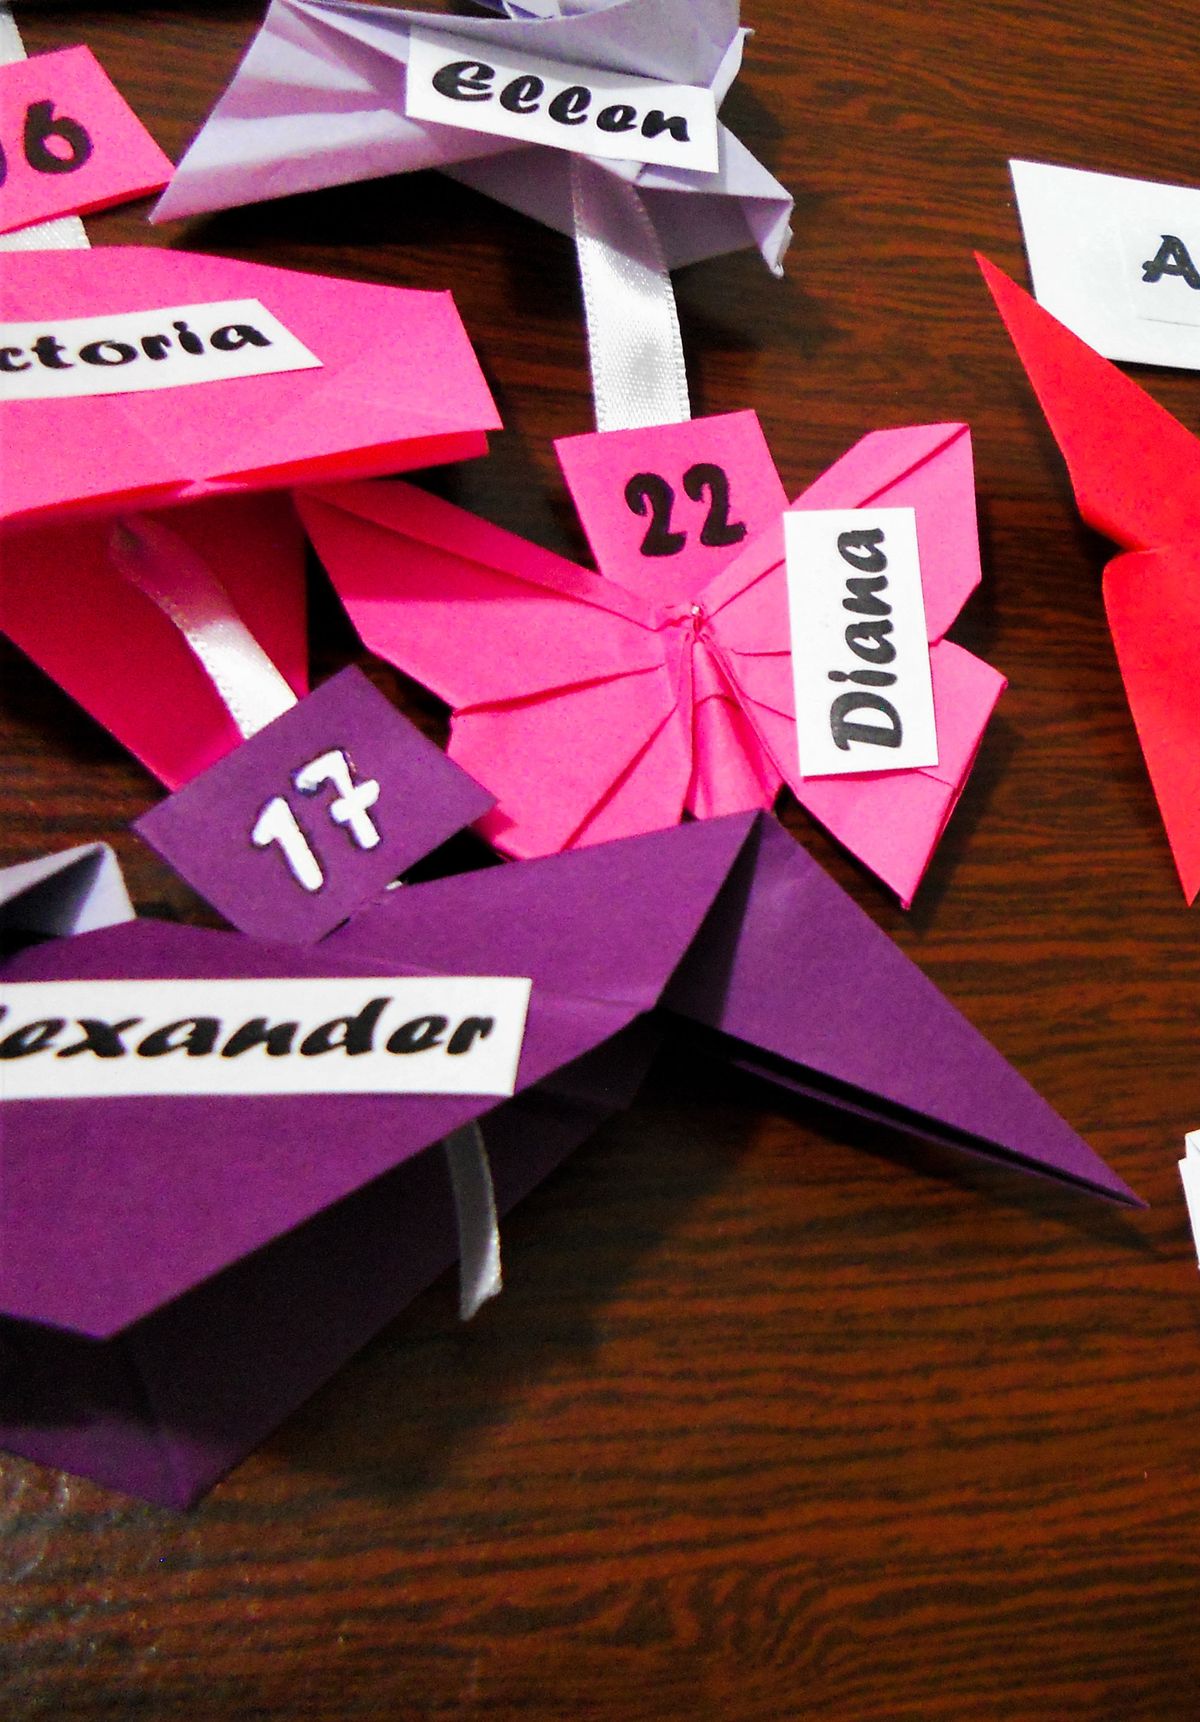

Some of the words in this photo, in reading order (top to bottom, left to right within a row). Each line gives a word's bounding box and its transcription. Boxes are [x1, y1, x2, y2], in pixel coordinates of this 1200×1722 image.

[0, 98, 94, 187] 6
[432, 60, 691, 143] Ellen
[0, 320, 272, 372] ctoria
[624, 463, 748, 557] 22
[827, 527, 904, 752] Diana
[251, 748, 382, 892] 17
[0, 998, 496, 1060] exander
